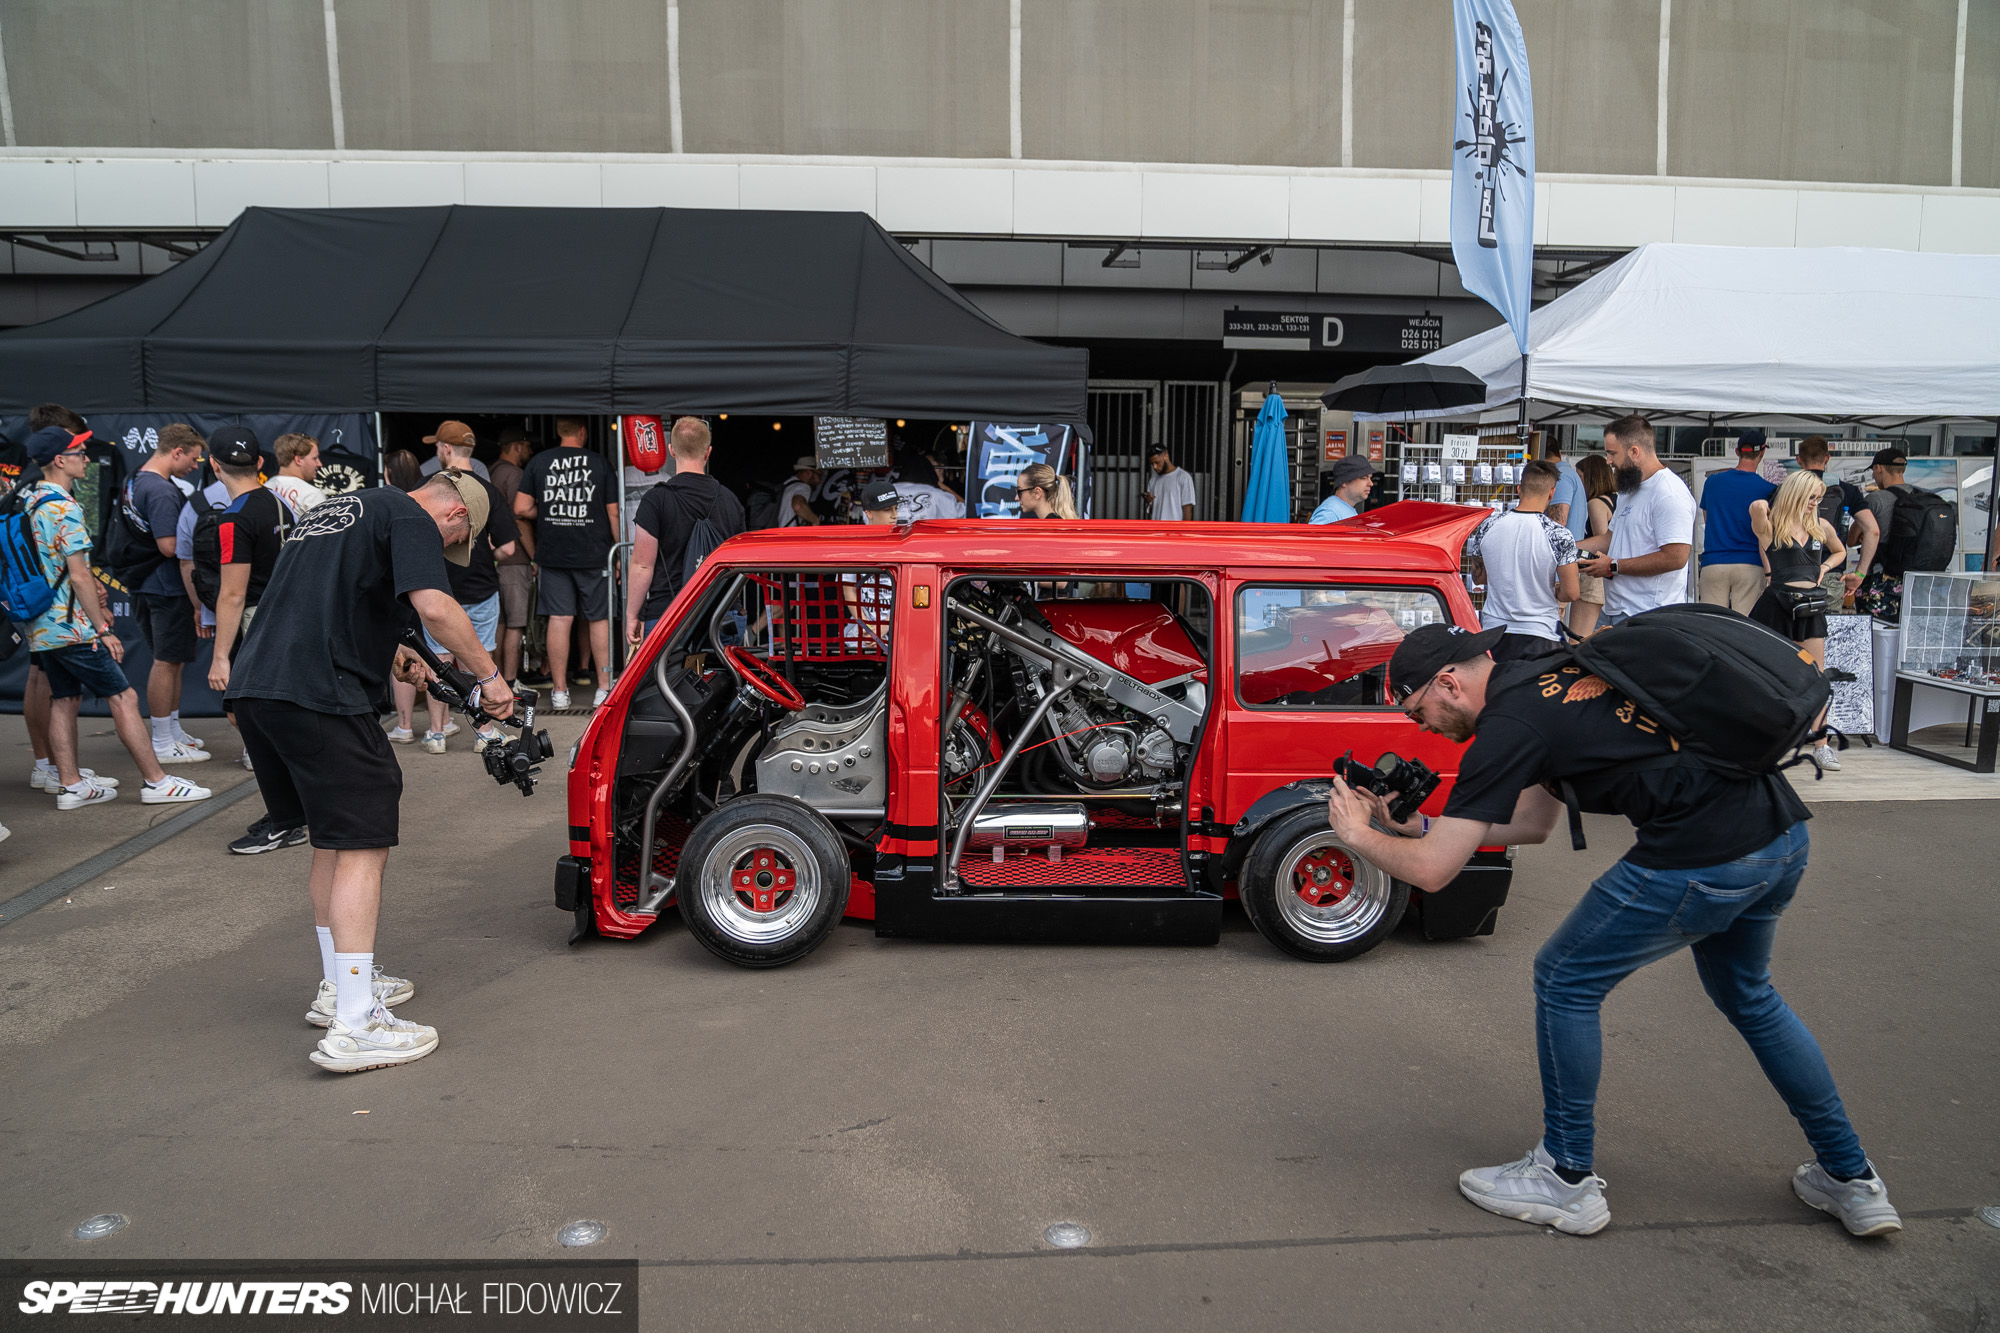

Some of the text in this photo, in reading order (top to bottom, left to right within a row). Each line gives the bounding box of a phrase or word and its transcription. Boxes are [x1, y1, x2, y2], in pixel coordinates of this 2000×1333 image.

[1280, 315, 1310, 324] SEKTOR
[1408, 317, 1440, 328] WEJŚCIA
[1228, 323, 1255, 332] 333-331,
[1322, 316, 1344, 347] D
[1401, 329, 1440, 340] D26 D14
[1401, 339, 1440, 350] D25 D13
[634, 419, 659, 455] 酒
[1451, 447, 1468, 458] 30 zł
[549, 455, 588, 471] ANTI
[546, 468, 593, 487] DAILY
[543, 484, 596, 503] DAILY
[549, 503, 588, 518] CLUB
[1117, 675, 1162, 702] DELTABOX
[525, 706, 534, 727] RONIN
